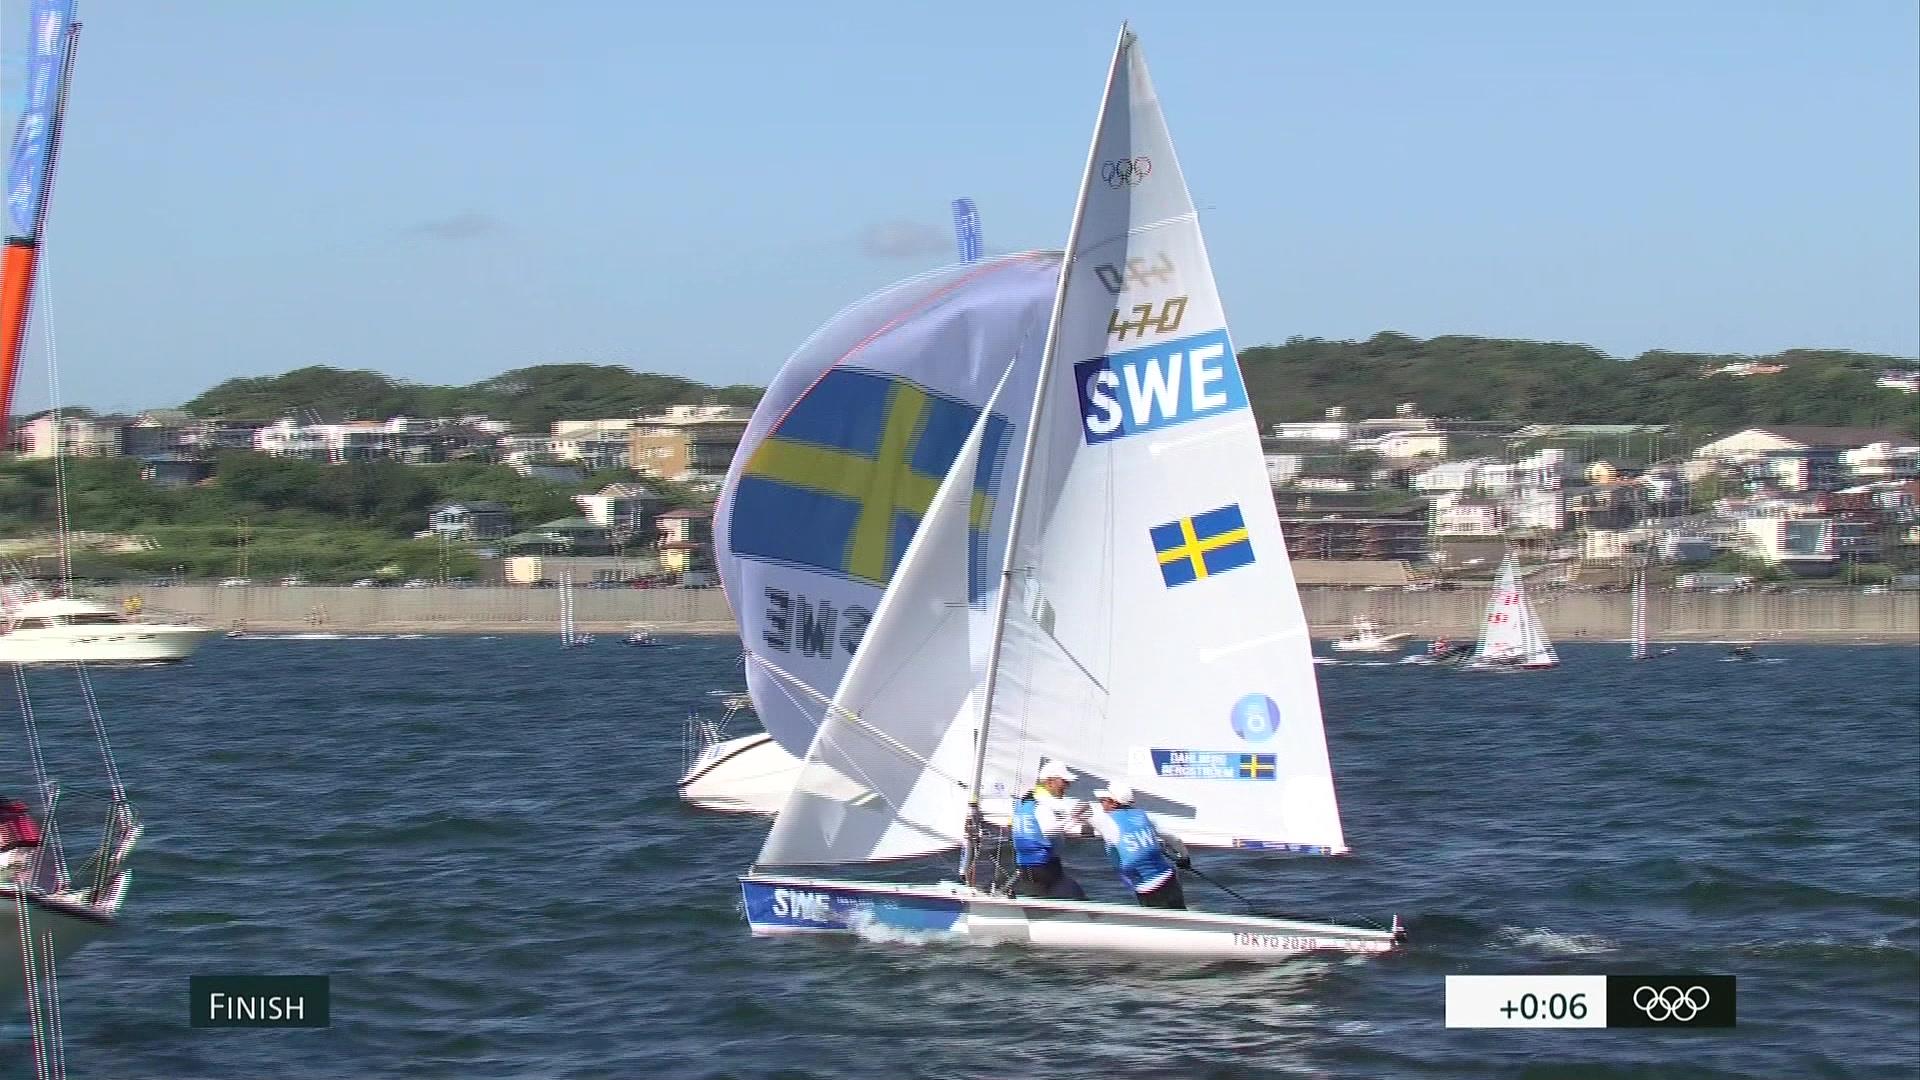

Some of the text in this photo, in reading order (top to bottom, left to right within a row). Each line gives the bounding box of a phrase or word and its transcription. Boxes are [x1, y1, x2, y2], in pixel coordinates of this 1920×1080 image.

[1107, 295, 1189, 341] 470
[1086, 342, 1228, 434] SWE
[772, 888, 832, 922] SWE
[1233, 932, 1317, 951] TOKYO 2020
